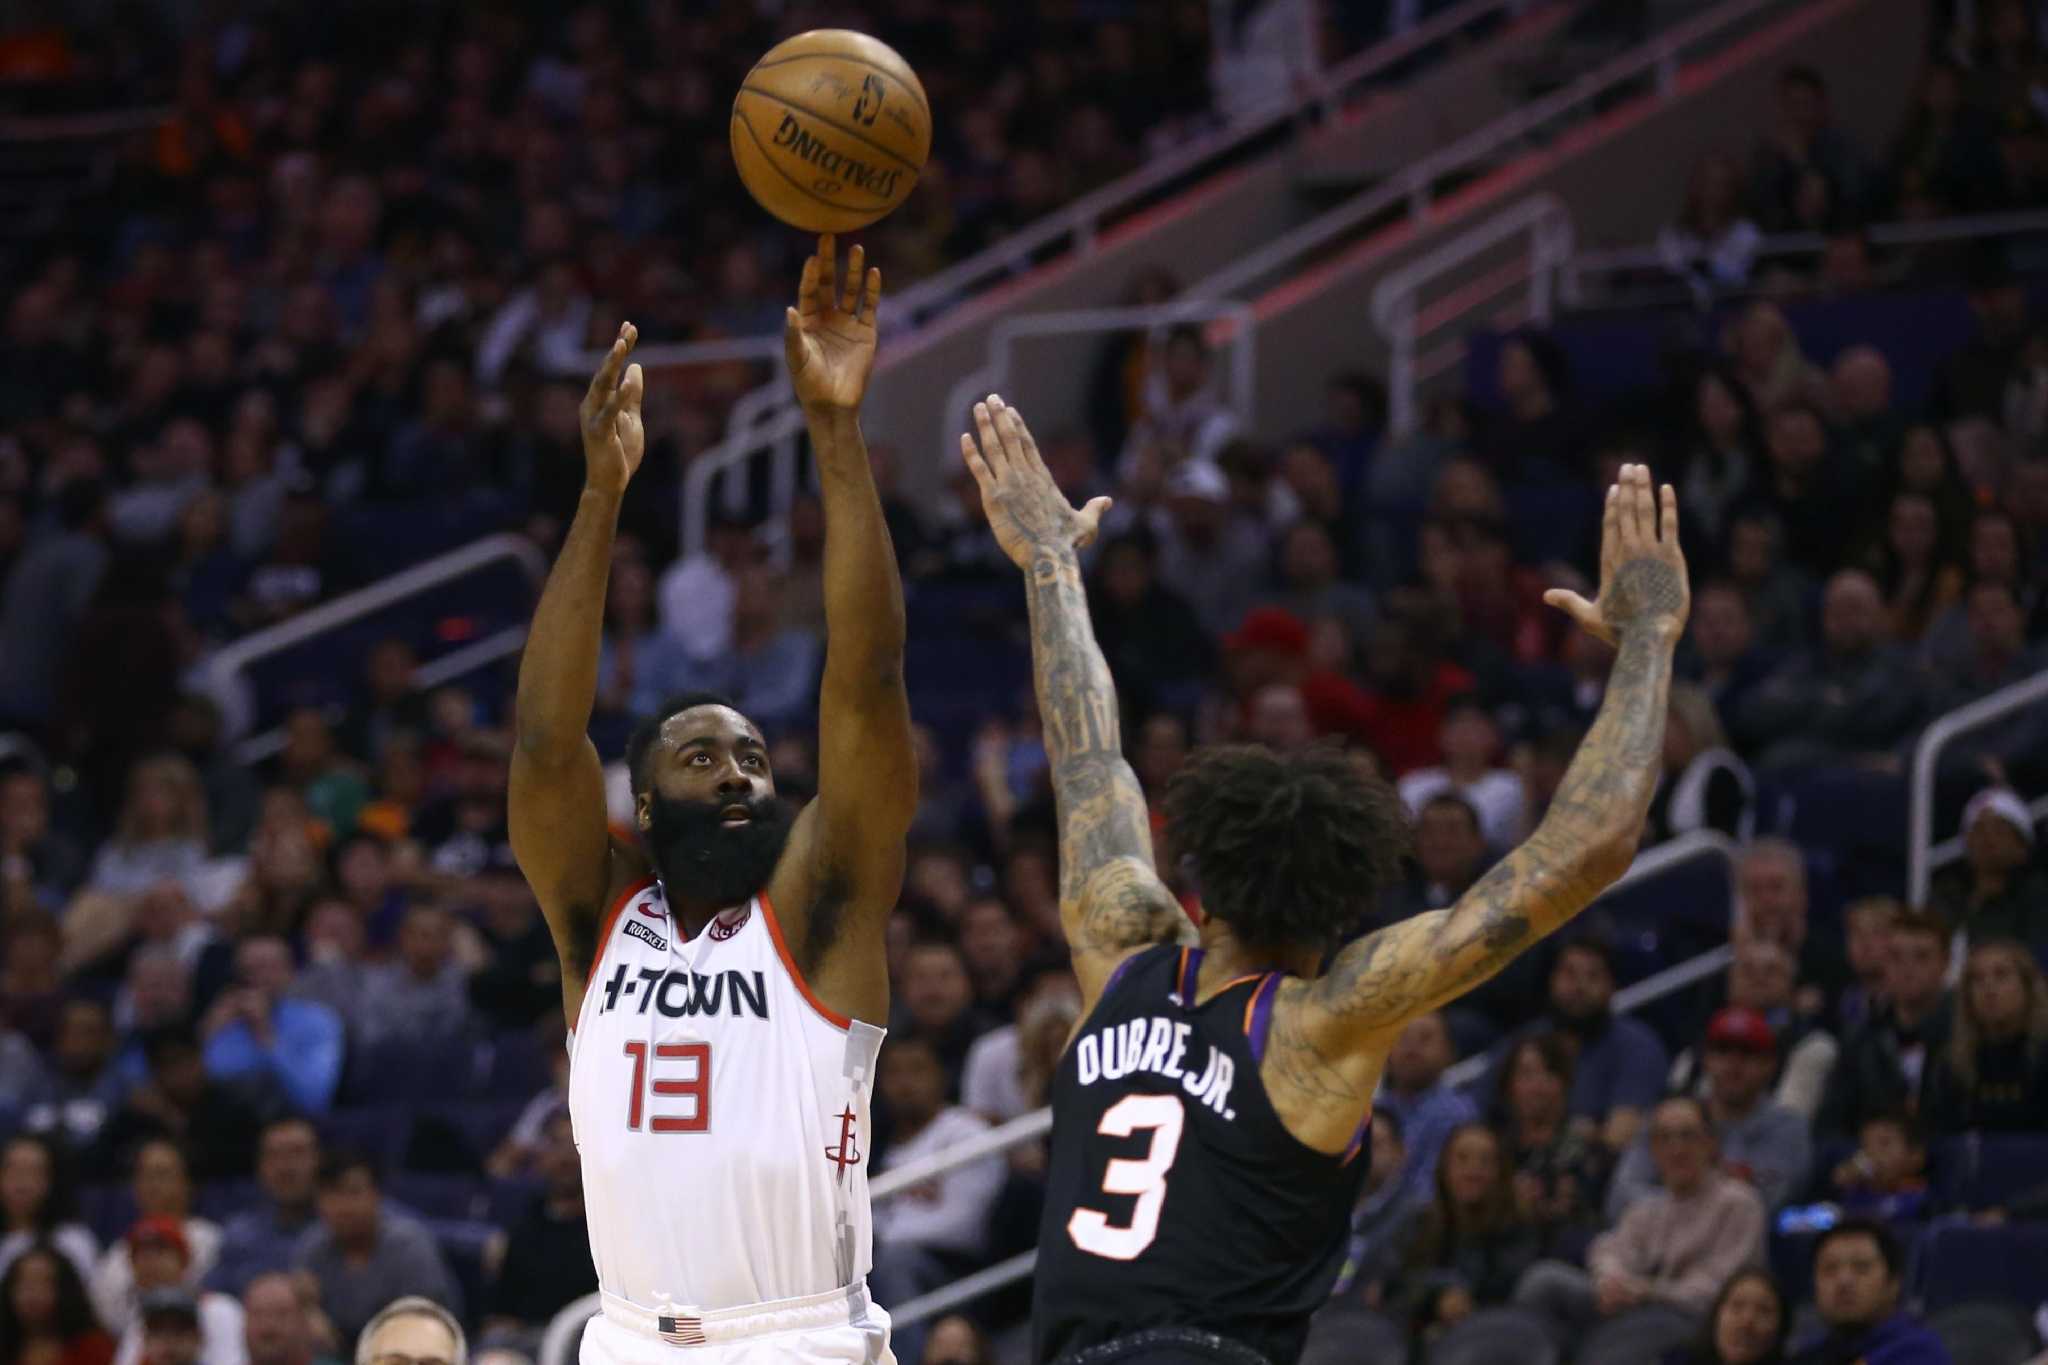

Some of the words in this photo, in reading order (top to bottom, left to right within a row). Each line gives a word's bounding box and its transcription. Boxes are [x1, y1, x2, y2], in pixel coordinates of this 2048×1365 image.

[773, 112, 903, 199] SPALDING
[600, 963, 769, 1021] H-TOWN
[623, 1039, 713, 1134] 13
[1077, 1016, 1192, 1086] OUBRE
[1182, 1045, 1236, 1121] JR.
[1067, 1094, 1185, 1260] 3
